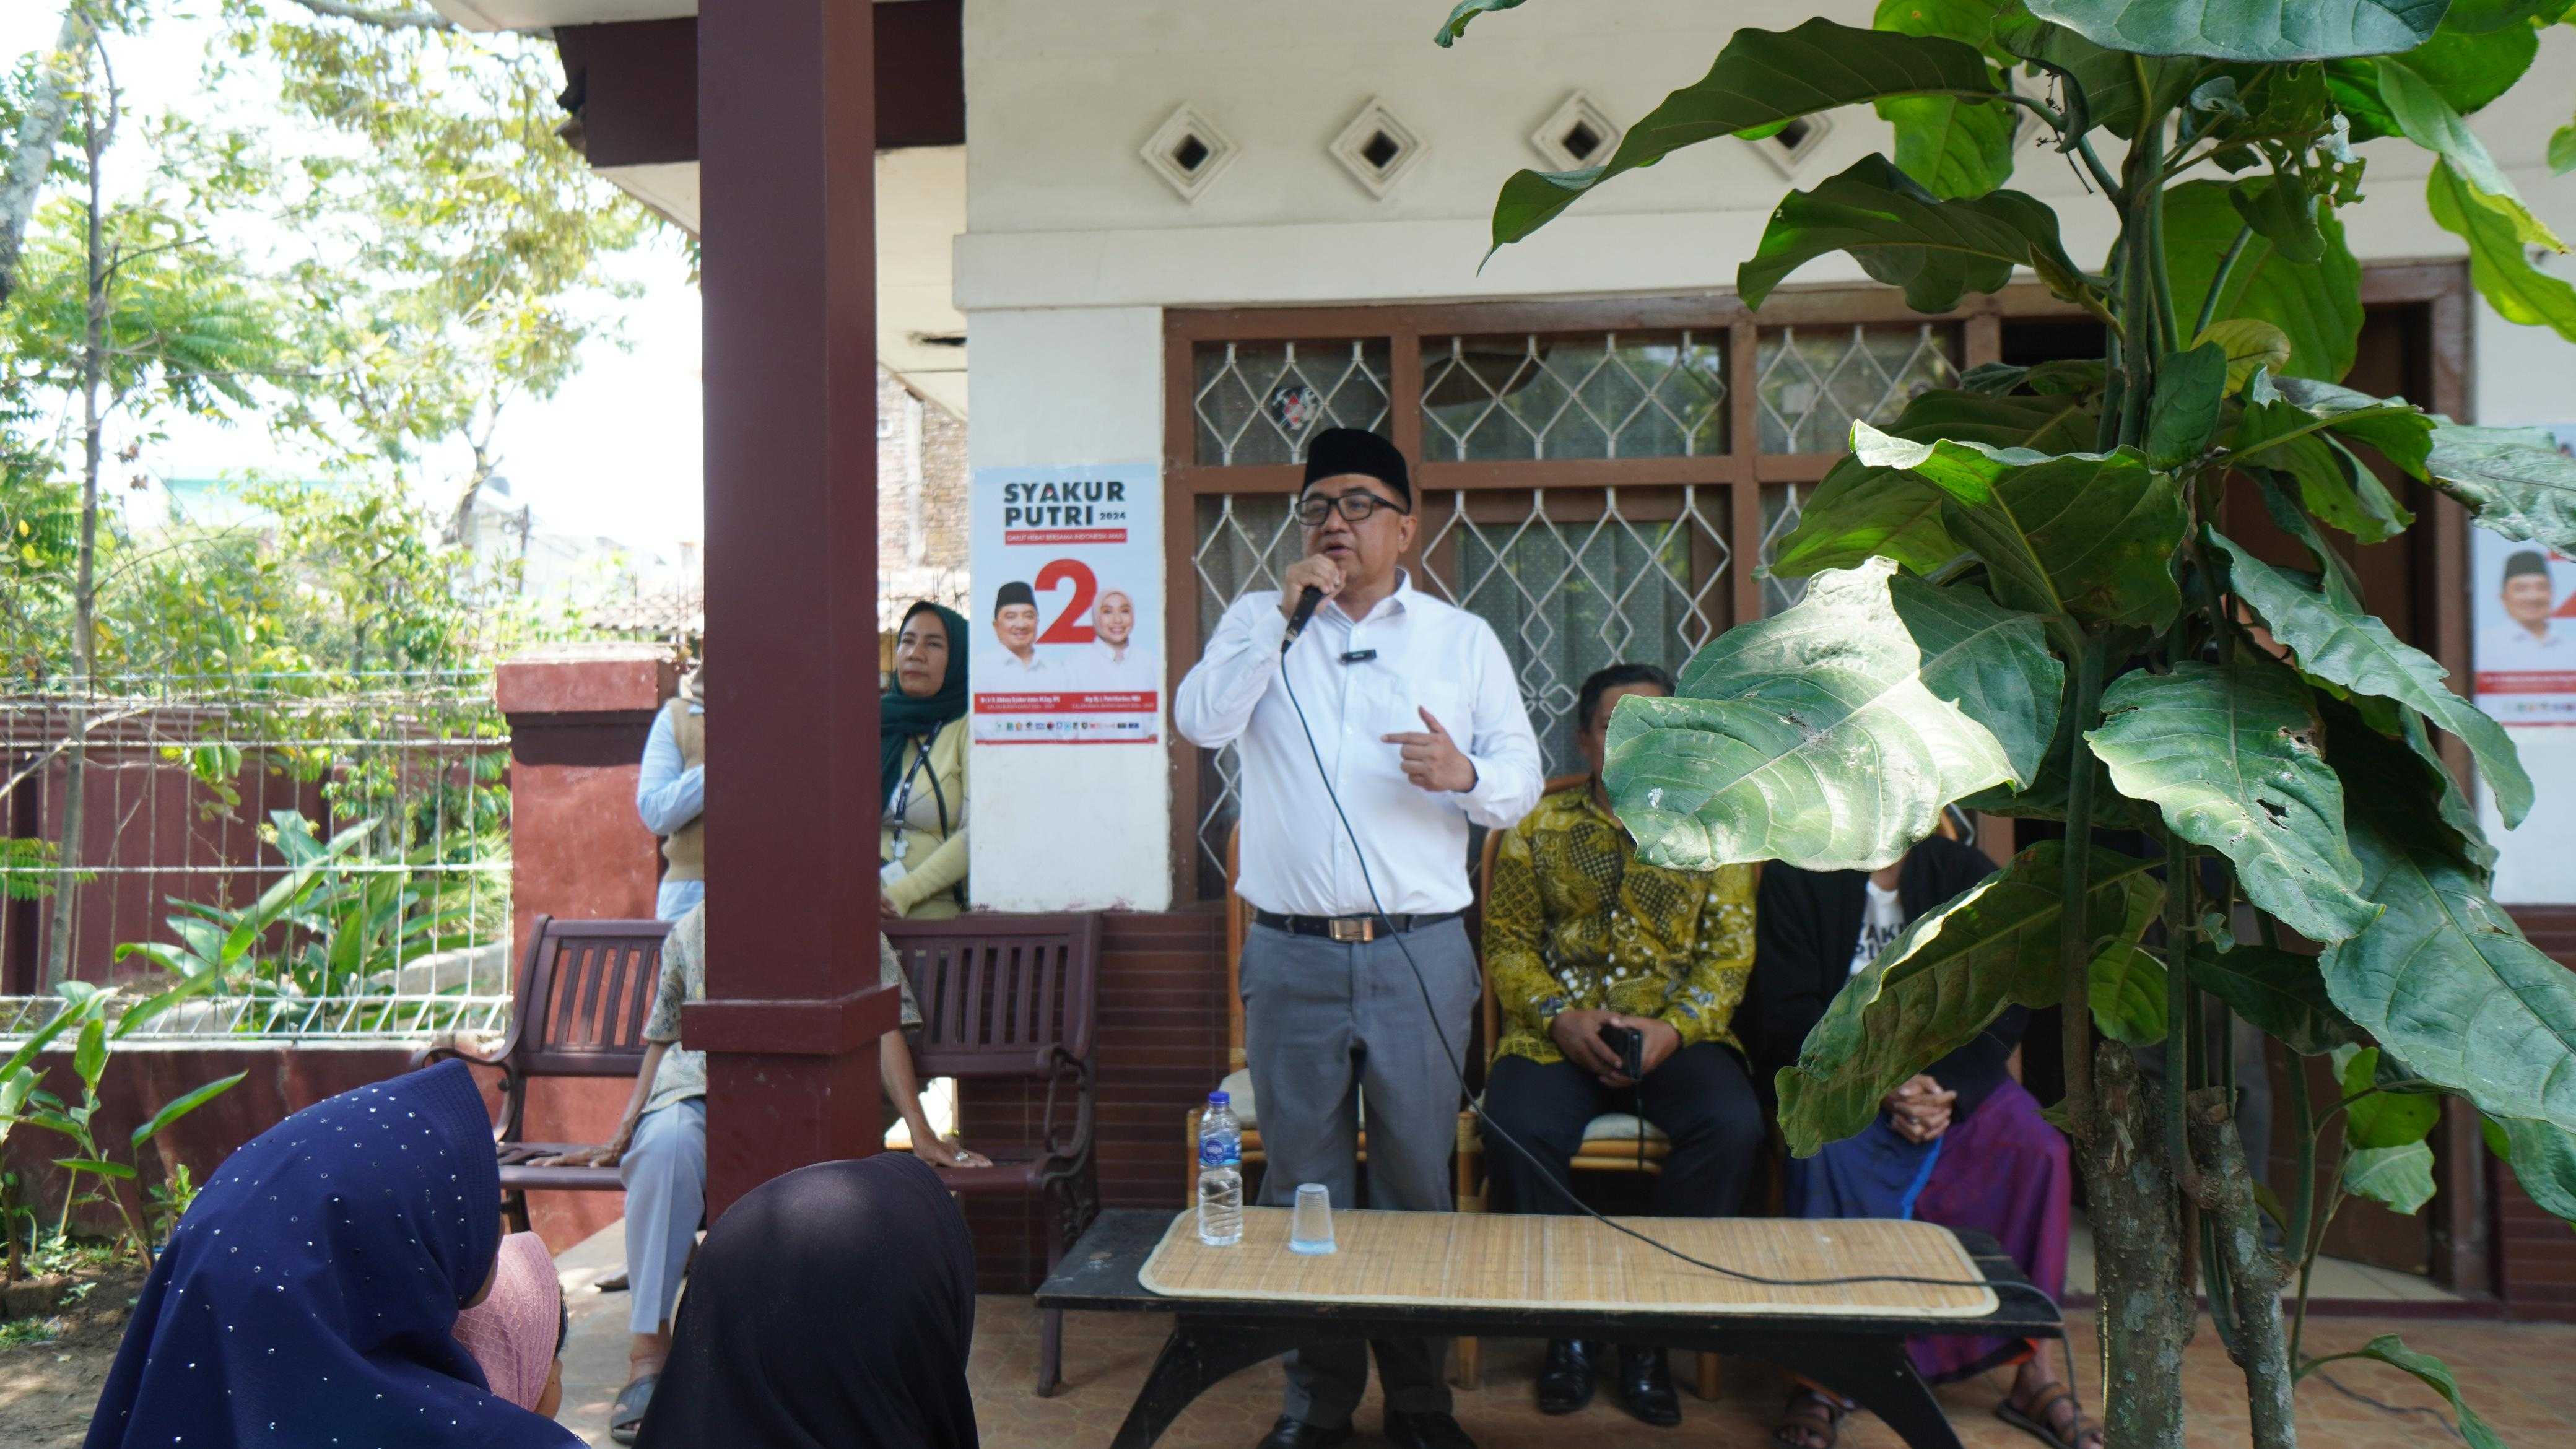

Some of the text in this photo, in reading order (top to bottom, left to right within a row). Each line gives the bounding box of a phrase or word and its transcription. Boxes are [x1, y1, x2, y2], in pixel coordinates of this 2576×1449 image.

[1004, 482, 1125, 503] SYAKUR
[1005, 505, 1126, 527] PUTRI 2024
[1035, 559, 1098, 644] 2
